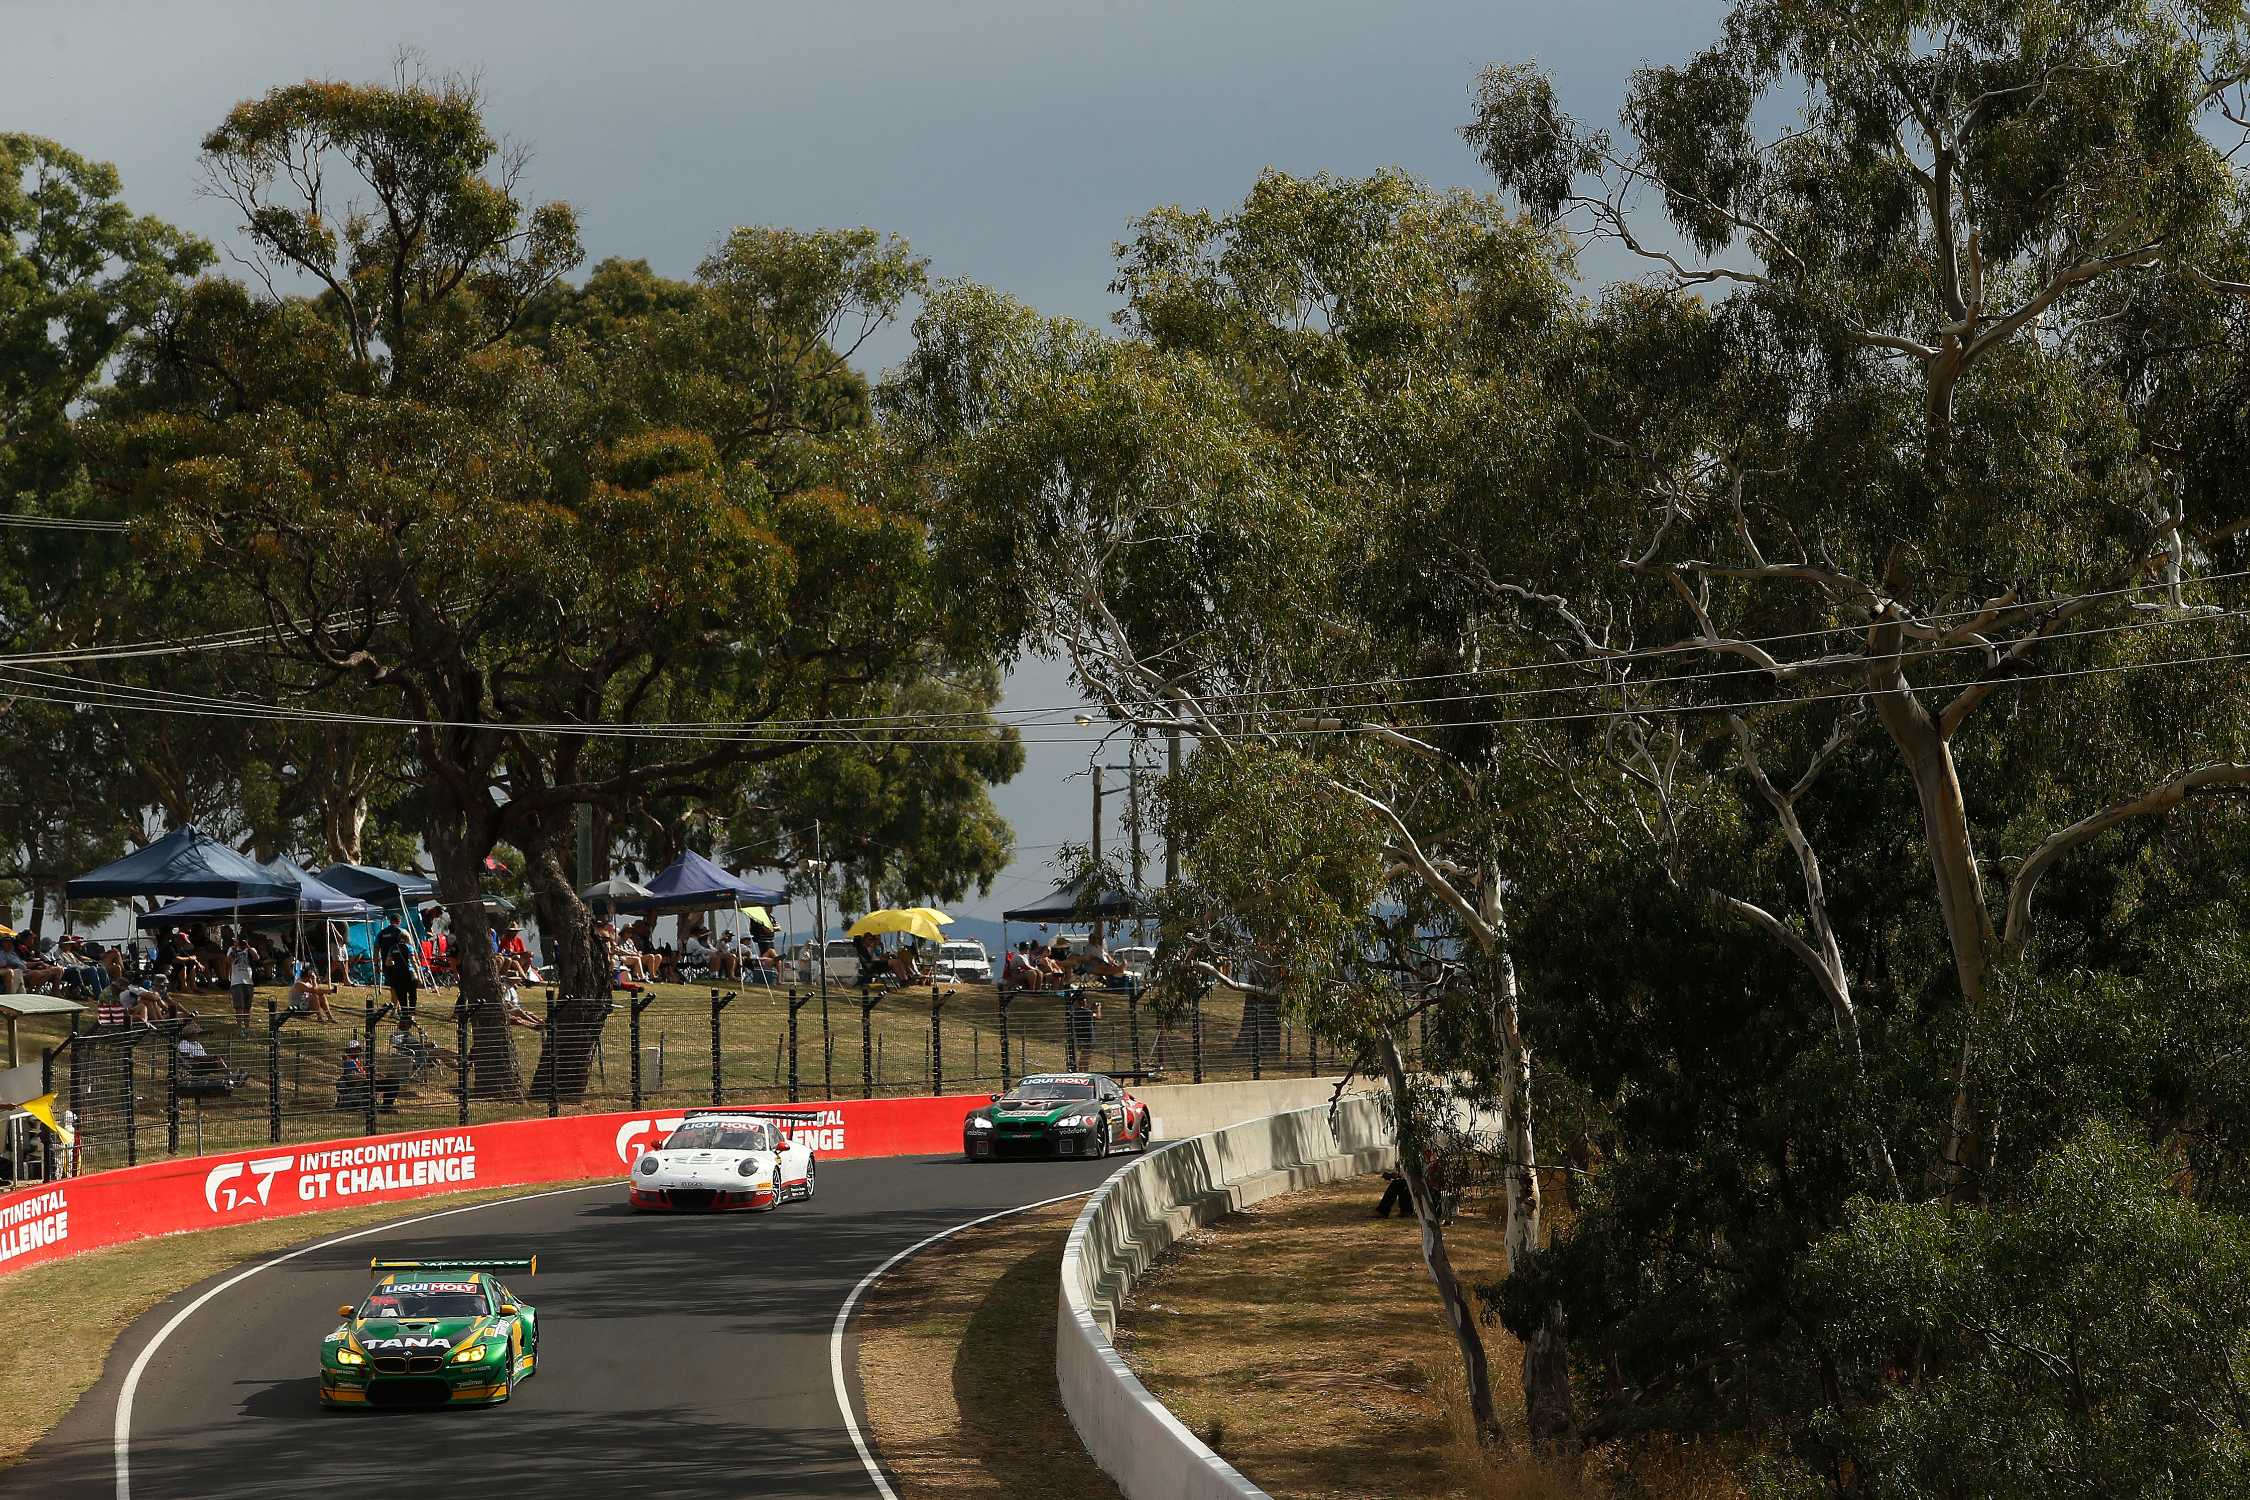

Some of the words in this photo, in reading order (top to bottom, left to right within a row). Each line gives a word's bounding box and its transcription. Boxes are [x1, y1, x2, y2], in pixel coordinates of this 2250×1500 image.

[684, 1122, 718, 1130] LIQUI
[720, 1122, 757, 1132] MOLY
[300, 1135, 475, 1172] INTERCONTINENTAL
[299, 1172, 331, 1200] GT
[336, 1155, 475, 1195] CHALLENGE
[0, 1211, 68, 1261] LLENGE
[385, 1283, 428, 1293] LIQUI
[431, 1282, 476, 1293] MOLY
[361, 1338, 451, 1350] TANA
